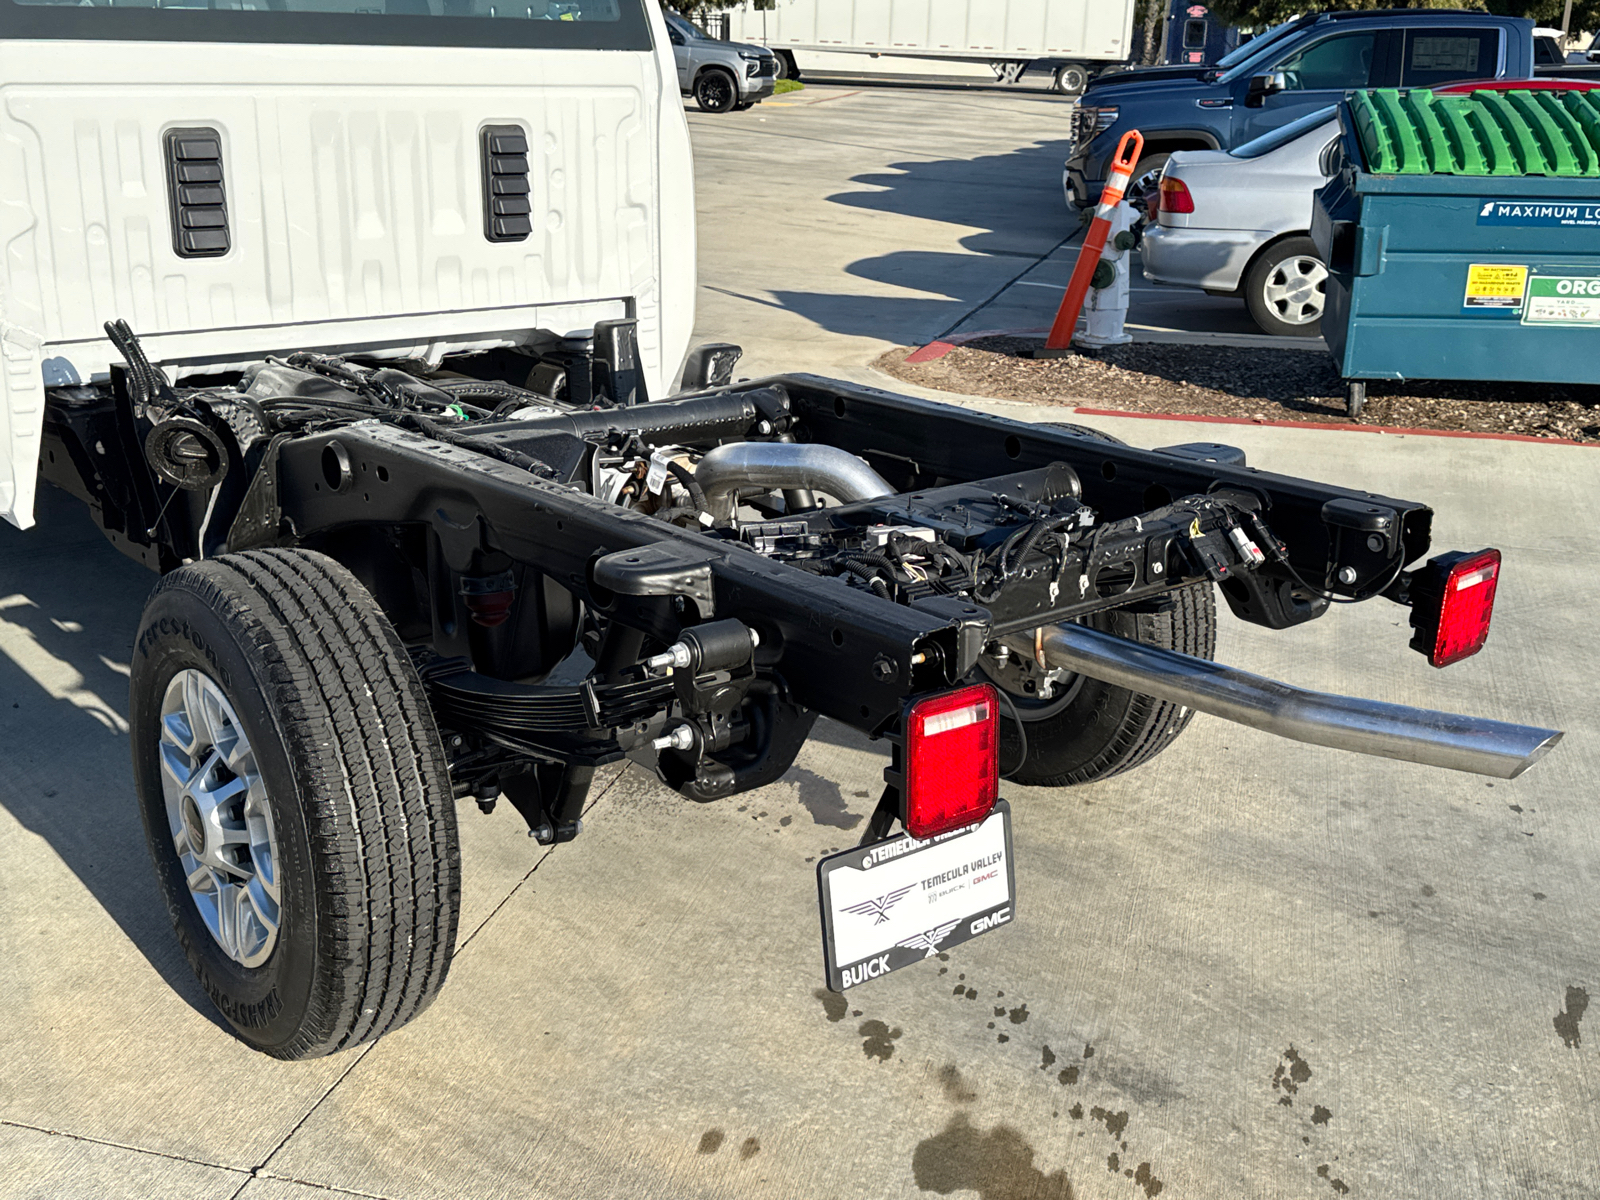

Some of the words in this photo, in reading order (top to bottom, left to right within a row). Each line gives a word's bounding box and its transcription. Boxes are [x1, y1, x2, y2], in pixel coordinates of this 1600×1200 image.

[1498, 206, 1578, 218] MAXIMUM
[1556, 280, 1600, 295] ORG
[920, 863, 969, 891] TEMECULA
[970, 850, 1003, 873] VALLEY
[972, 869, 998, 885] GMC
[970, 907, 1011, 935] GMC
[841, 954, 891, 989] BUICK
